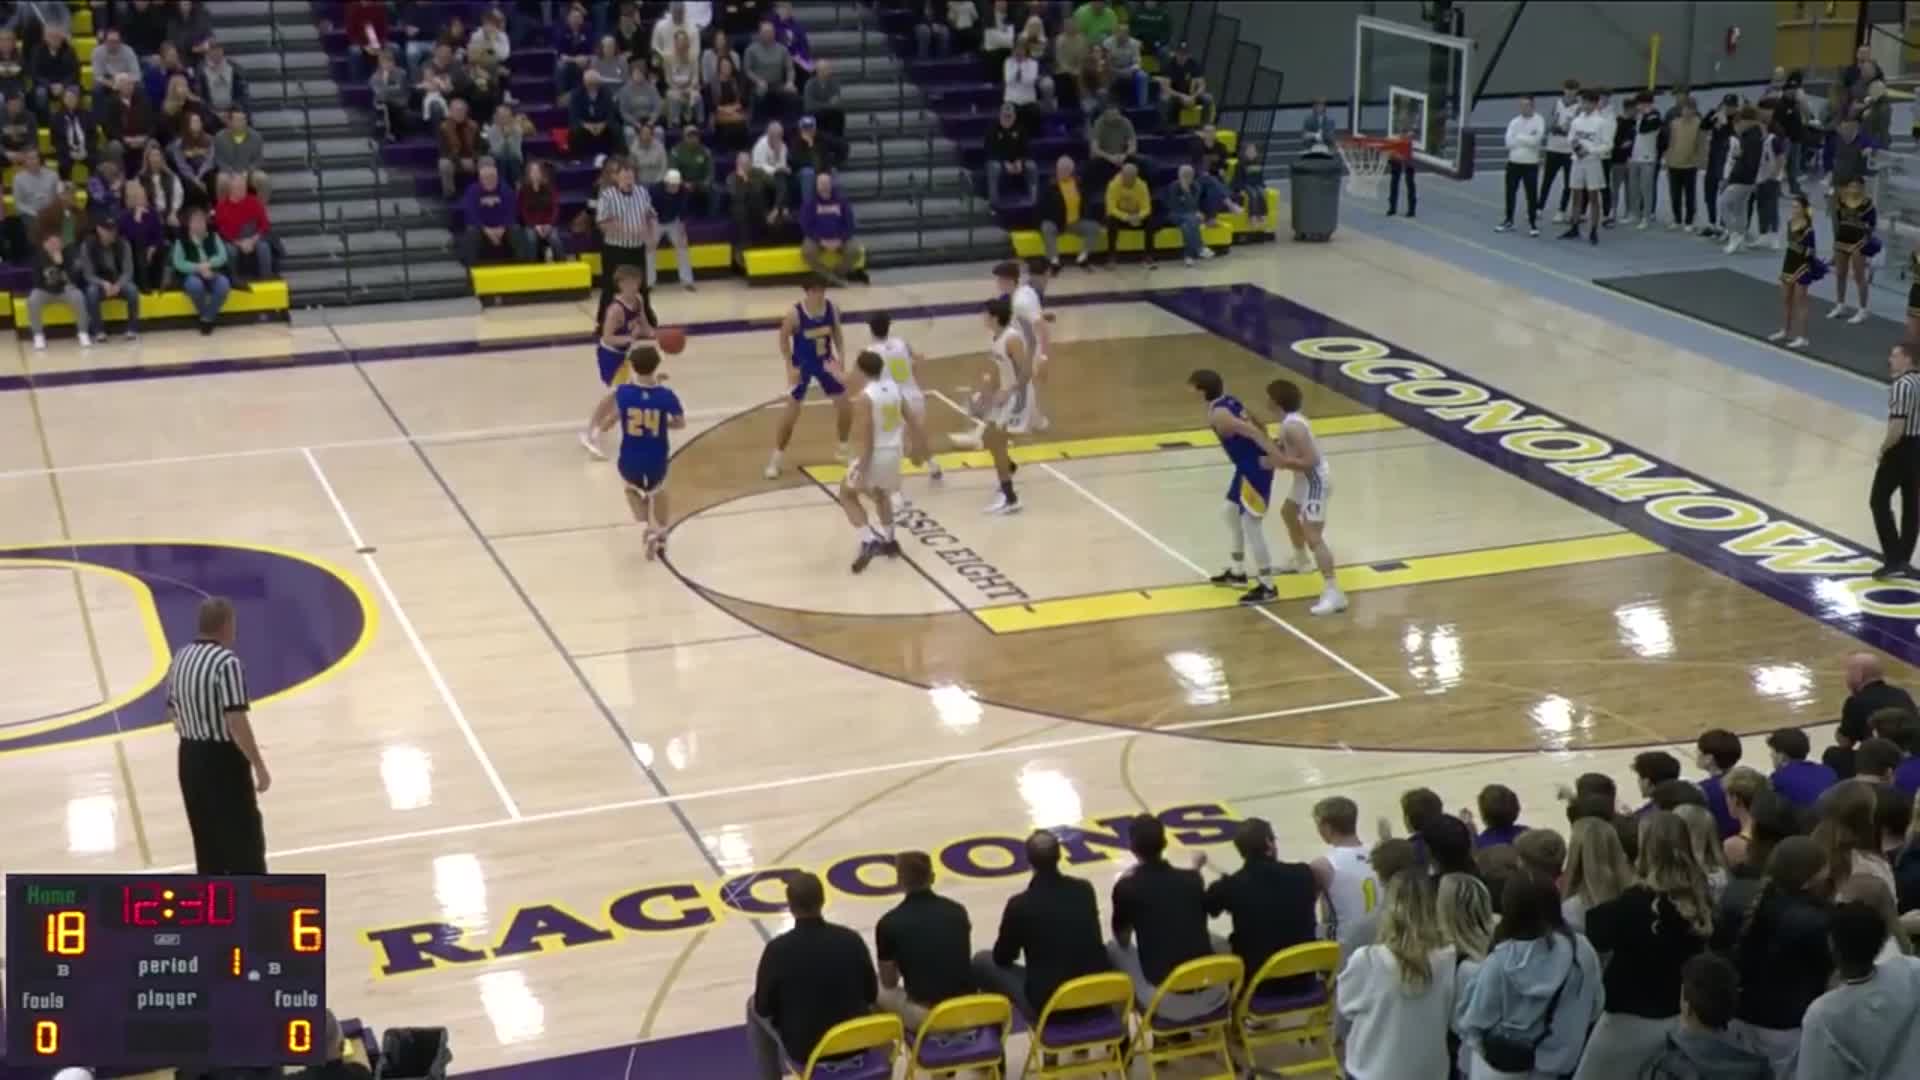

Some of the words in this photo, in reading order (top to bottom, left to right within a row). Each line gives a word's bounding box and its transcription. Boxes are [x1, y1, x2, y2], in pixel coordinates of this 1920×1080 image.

[627, 407, 660, 437] 24
[1290, 336, 1920, 638] OCONOMOWO
[936, 547, 1029, 599] EIGHT
